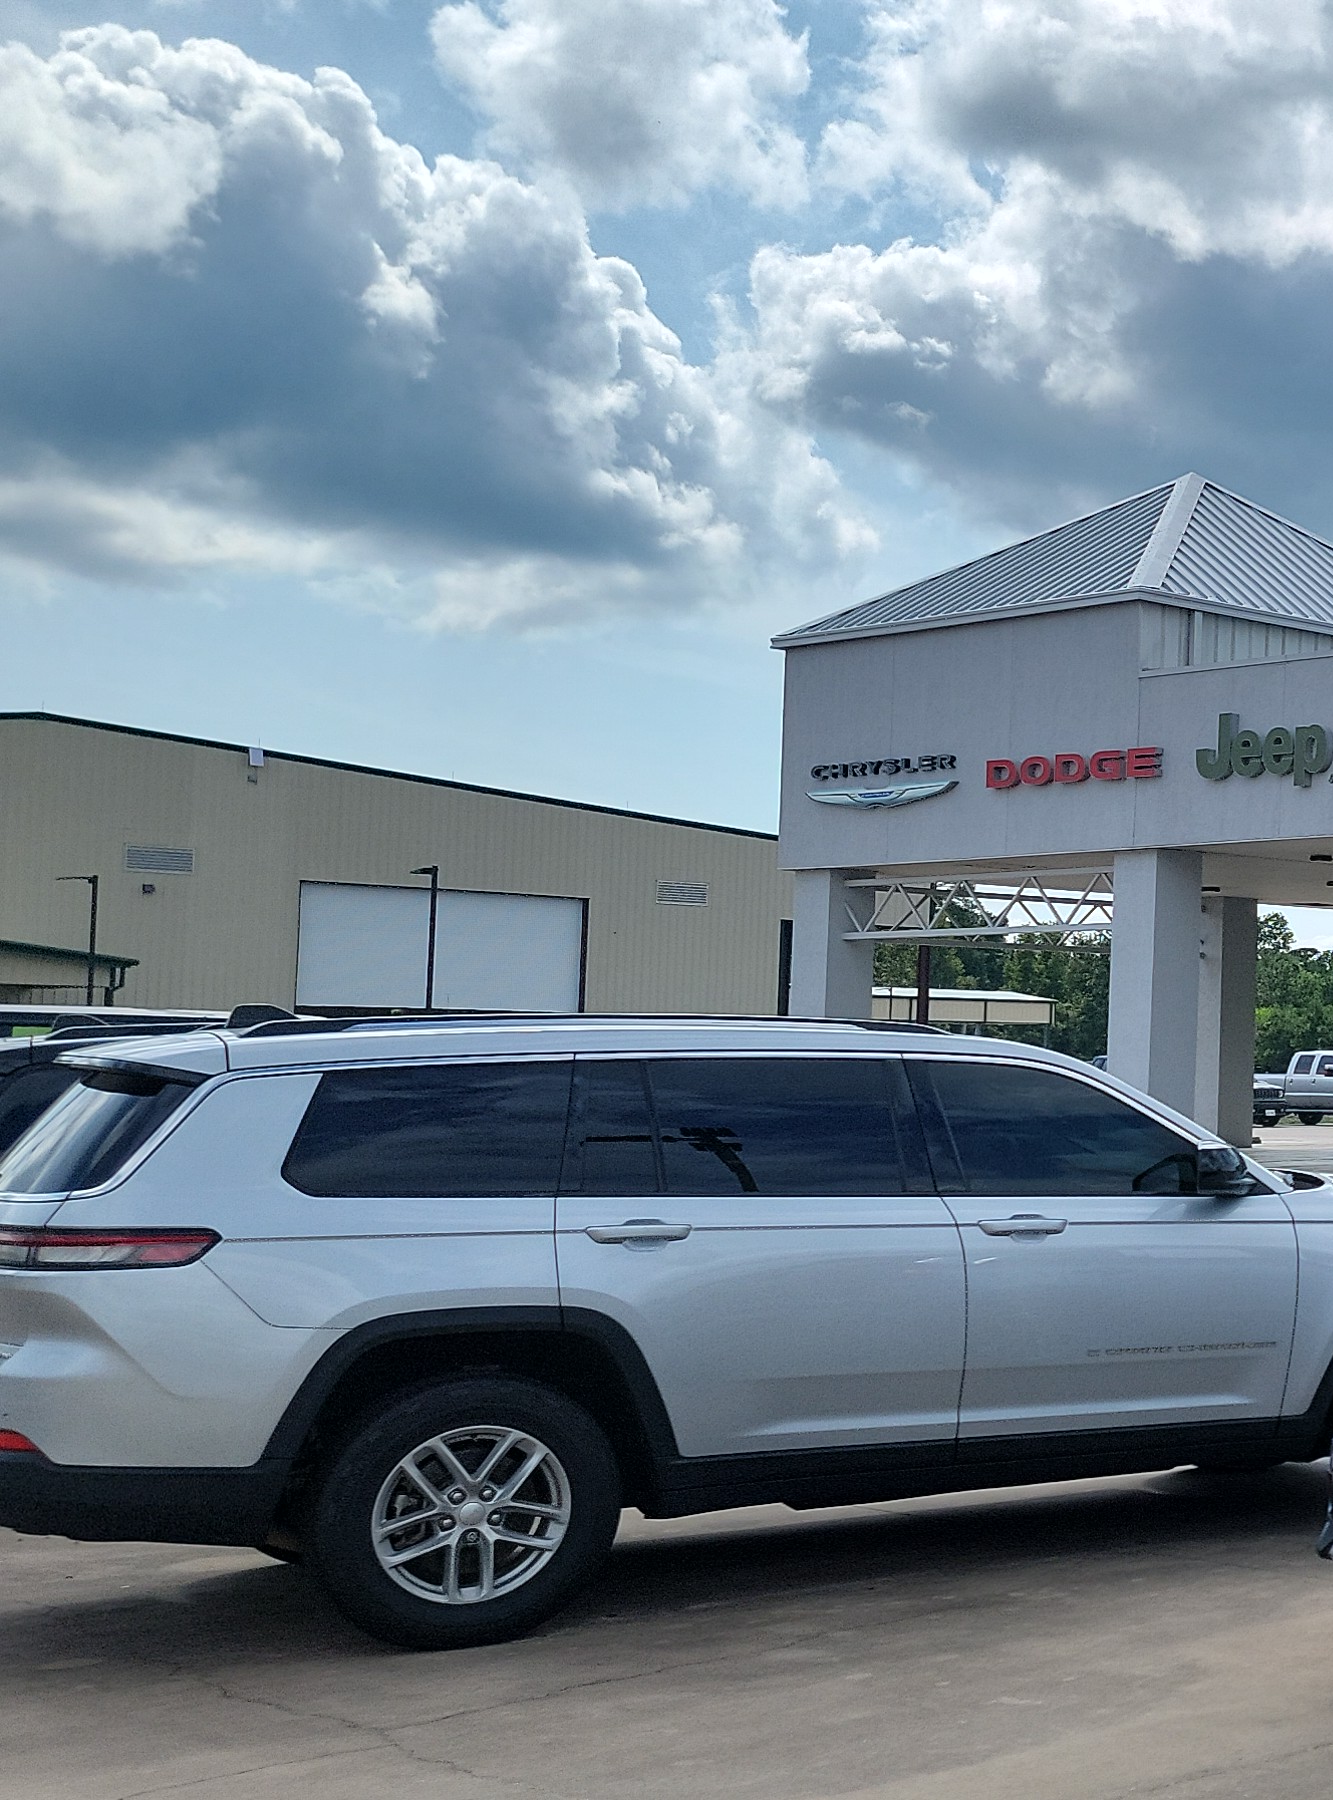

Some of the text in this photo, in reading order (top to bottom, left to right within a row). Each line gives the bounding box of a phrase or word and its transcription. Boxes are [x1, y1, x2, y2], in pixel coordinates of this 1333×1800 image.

[810, 753, 957, 782] CHRYSLER
[985, 746, 1163, 790] DODGE
[1195, 711, 1333, 788] Jeep
